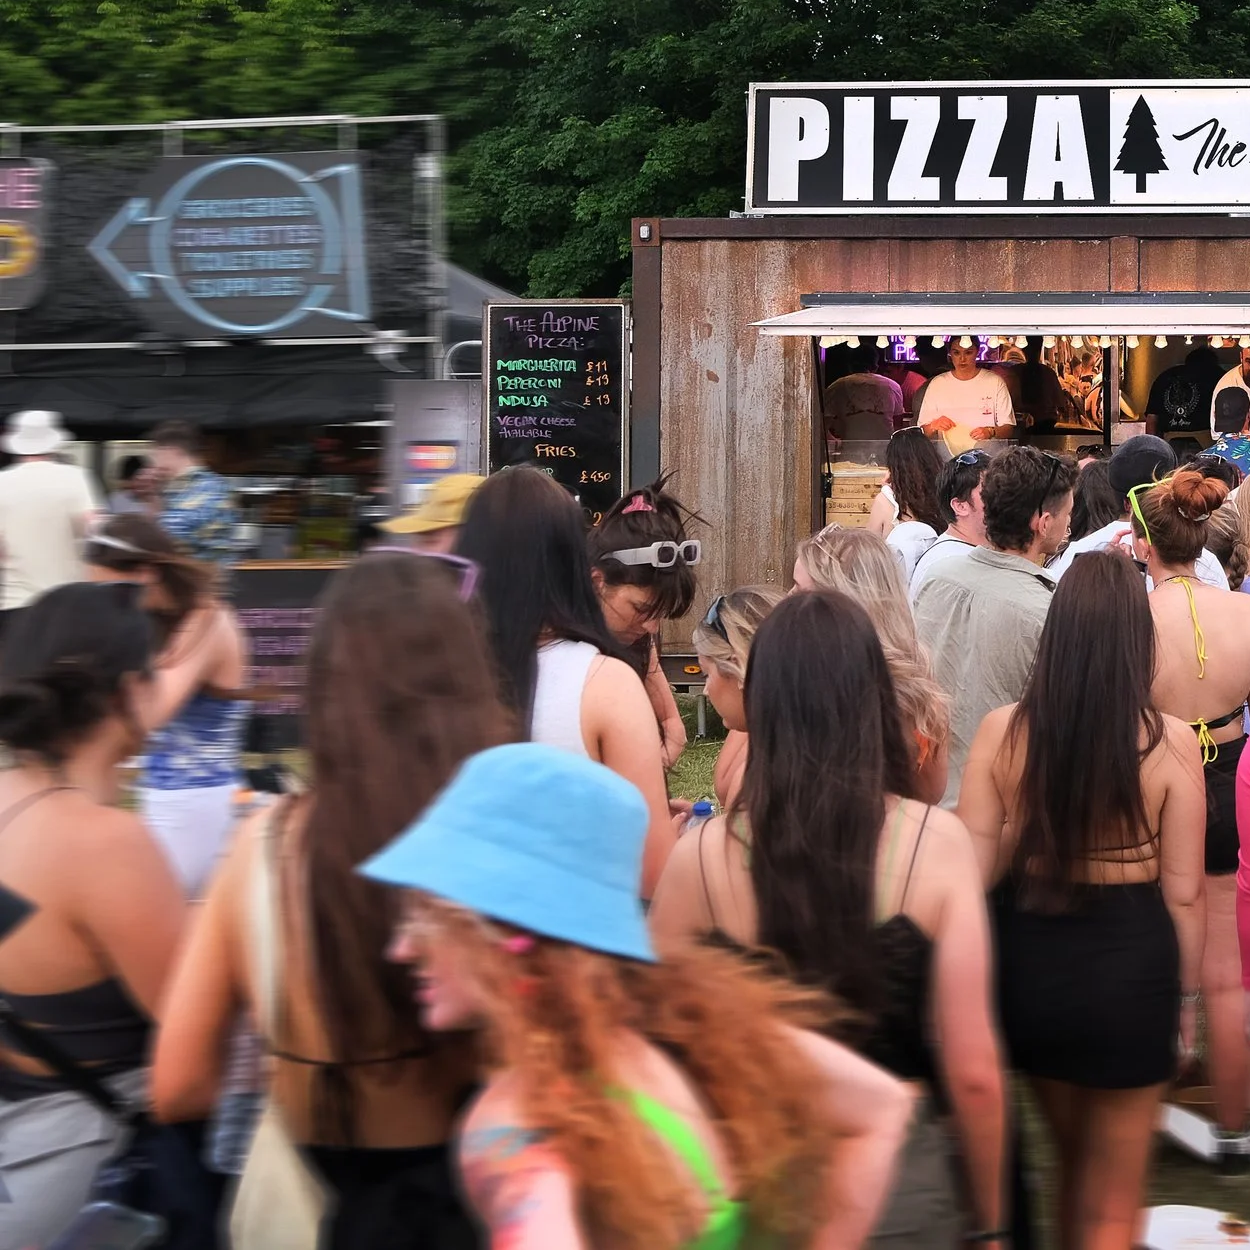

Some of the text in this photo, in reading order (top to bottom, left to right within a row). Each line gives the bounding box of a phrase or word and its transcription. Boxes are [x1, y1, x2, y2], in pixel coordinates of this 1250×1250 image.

[768, 95, 1095, 201] PIZZA
[1172, 118, 1247, 175] The
[504, 311, 600, 333] THE ALPINE
[496, 359, 608, 373] MARGHERITA £11
[497, 376, 562, 390] PEPERONI
[498, 394, 549, 407] NDUSA
[496, 416, 577, 427] VEGAN CHEESE
[499, 427, 552, 438] AVAILABLE
[535, 444, 576, 457] FRIES
